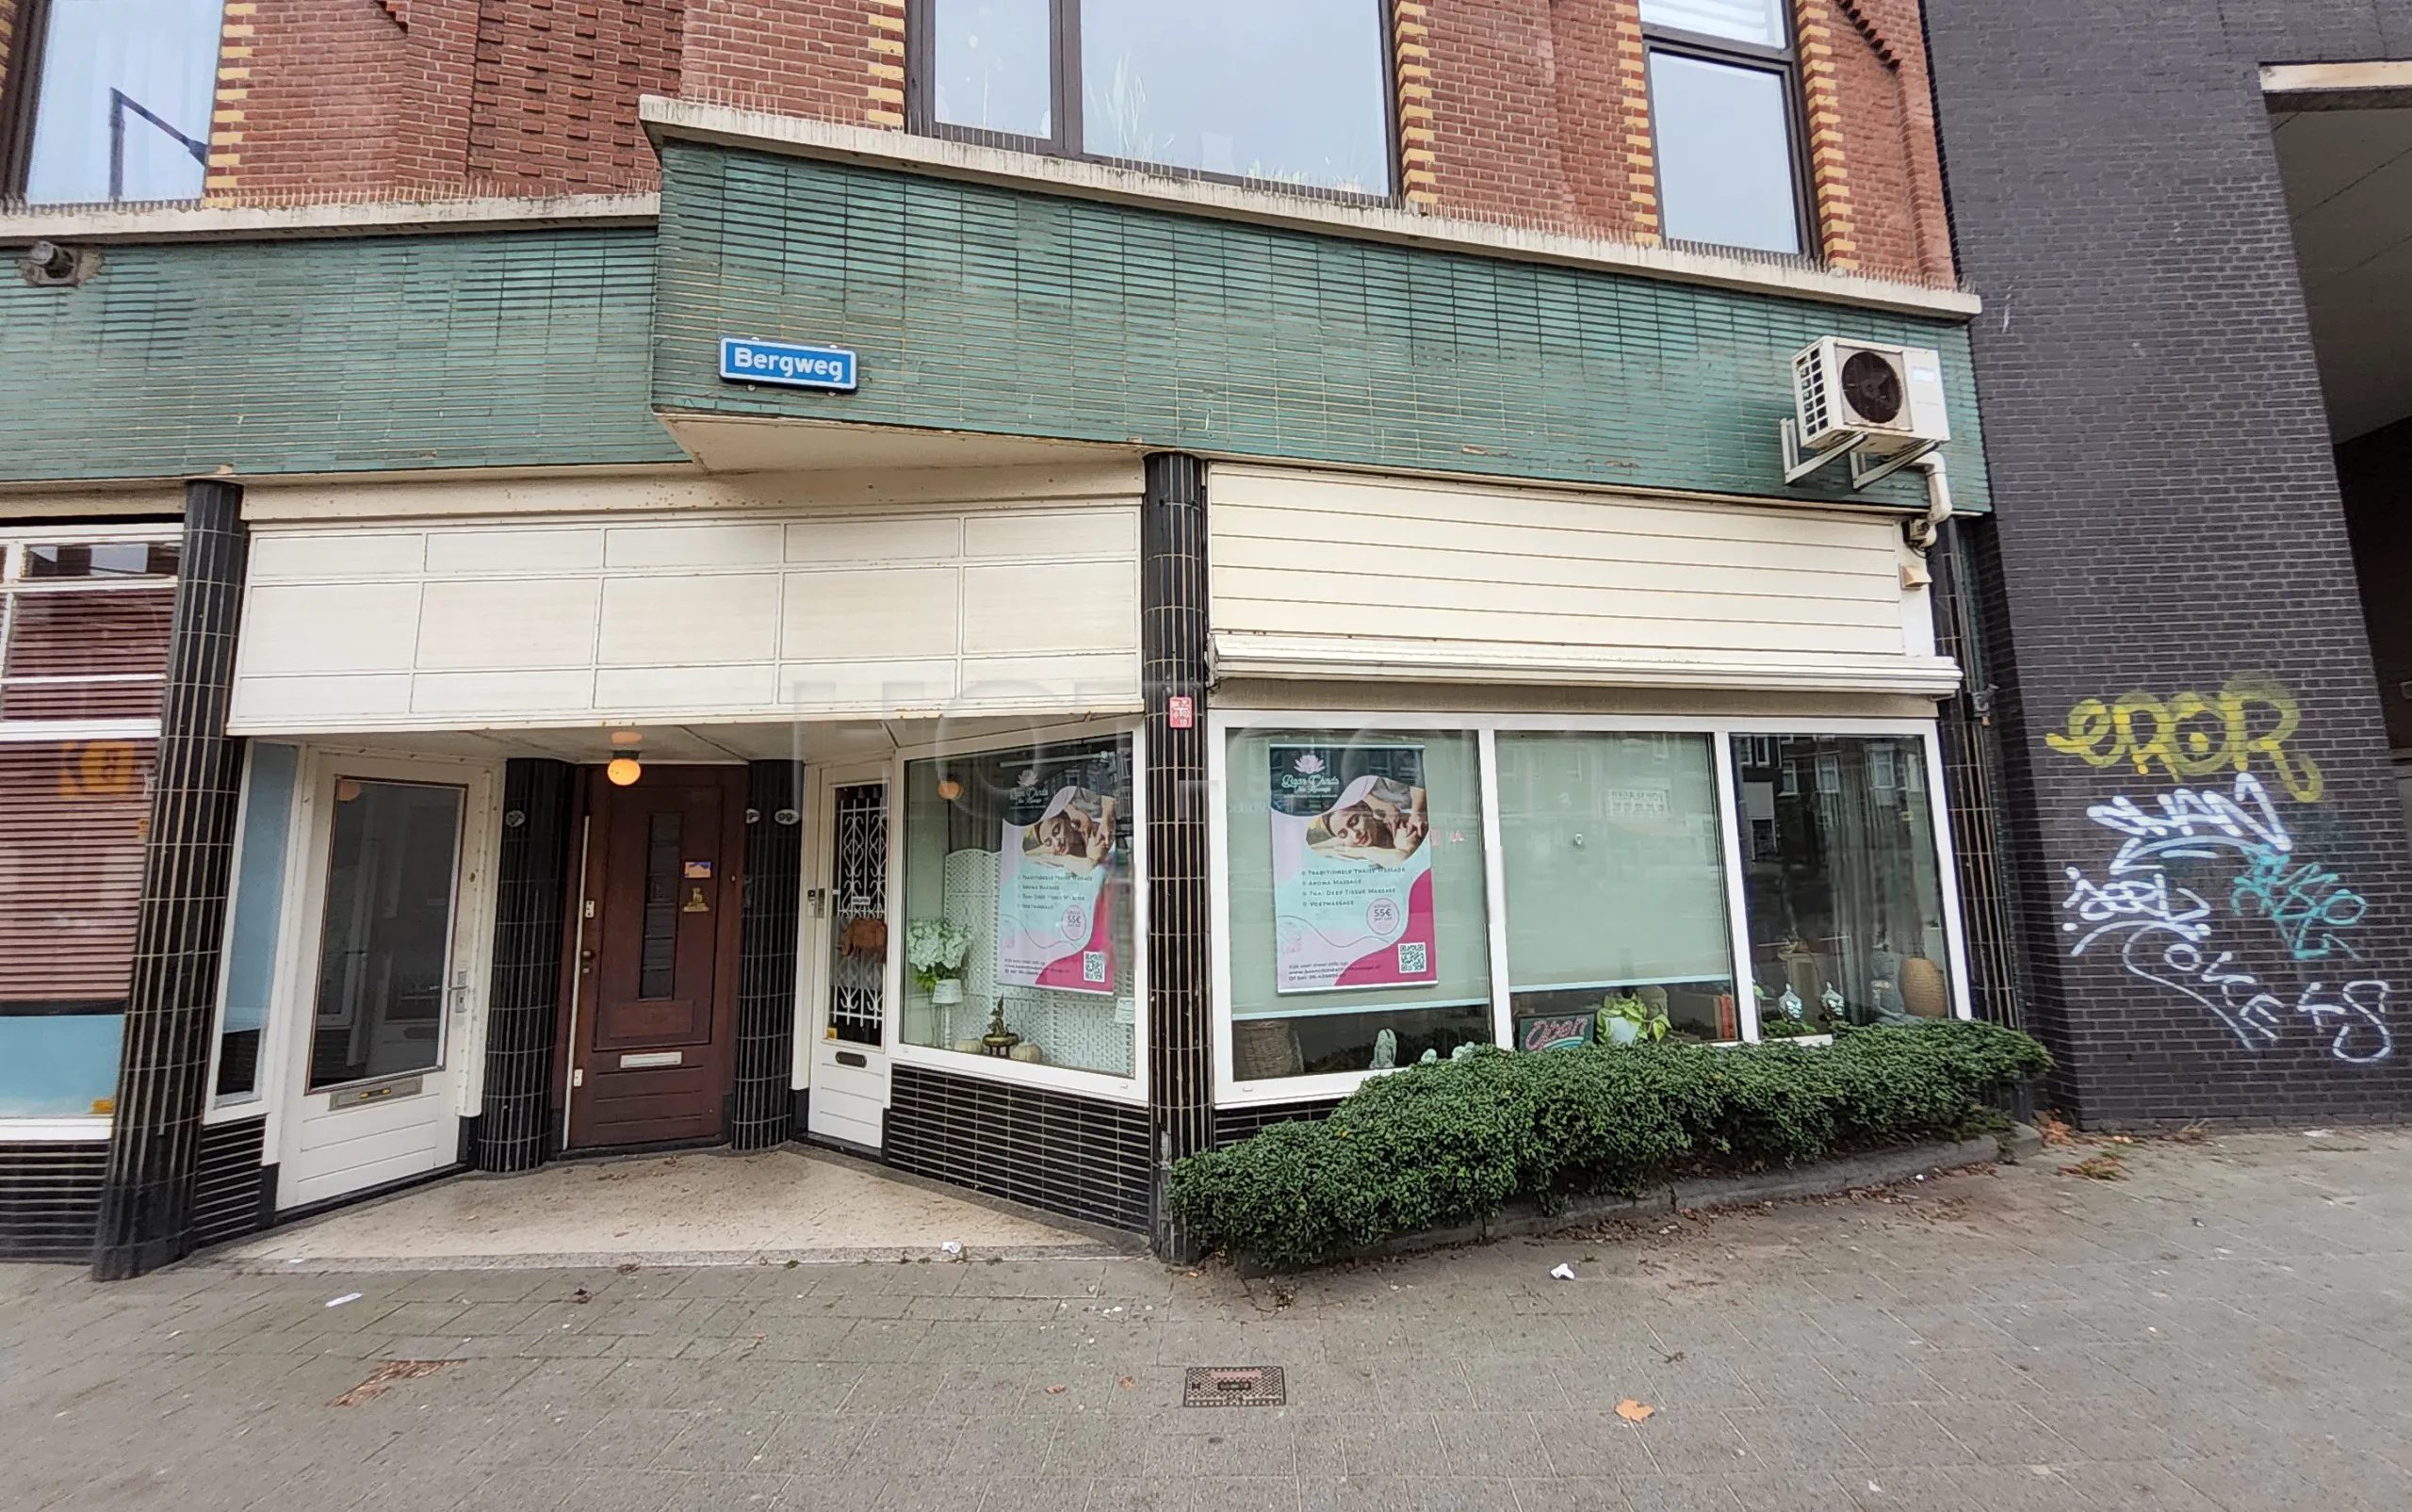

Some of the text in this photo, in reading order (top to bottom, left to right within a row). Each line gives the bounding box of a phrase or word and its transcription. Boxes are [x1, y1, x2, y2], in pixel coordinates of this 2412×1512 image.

[733, 346, 843, 382] Bergweg
[1373, 908, 1393, 918] 55€
[1525, 1016, 1589, 1053] Open
